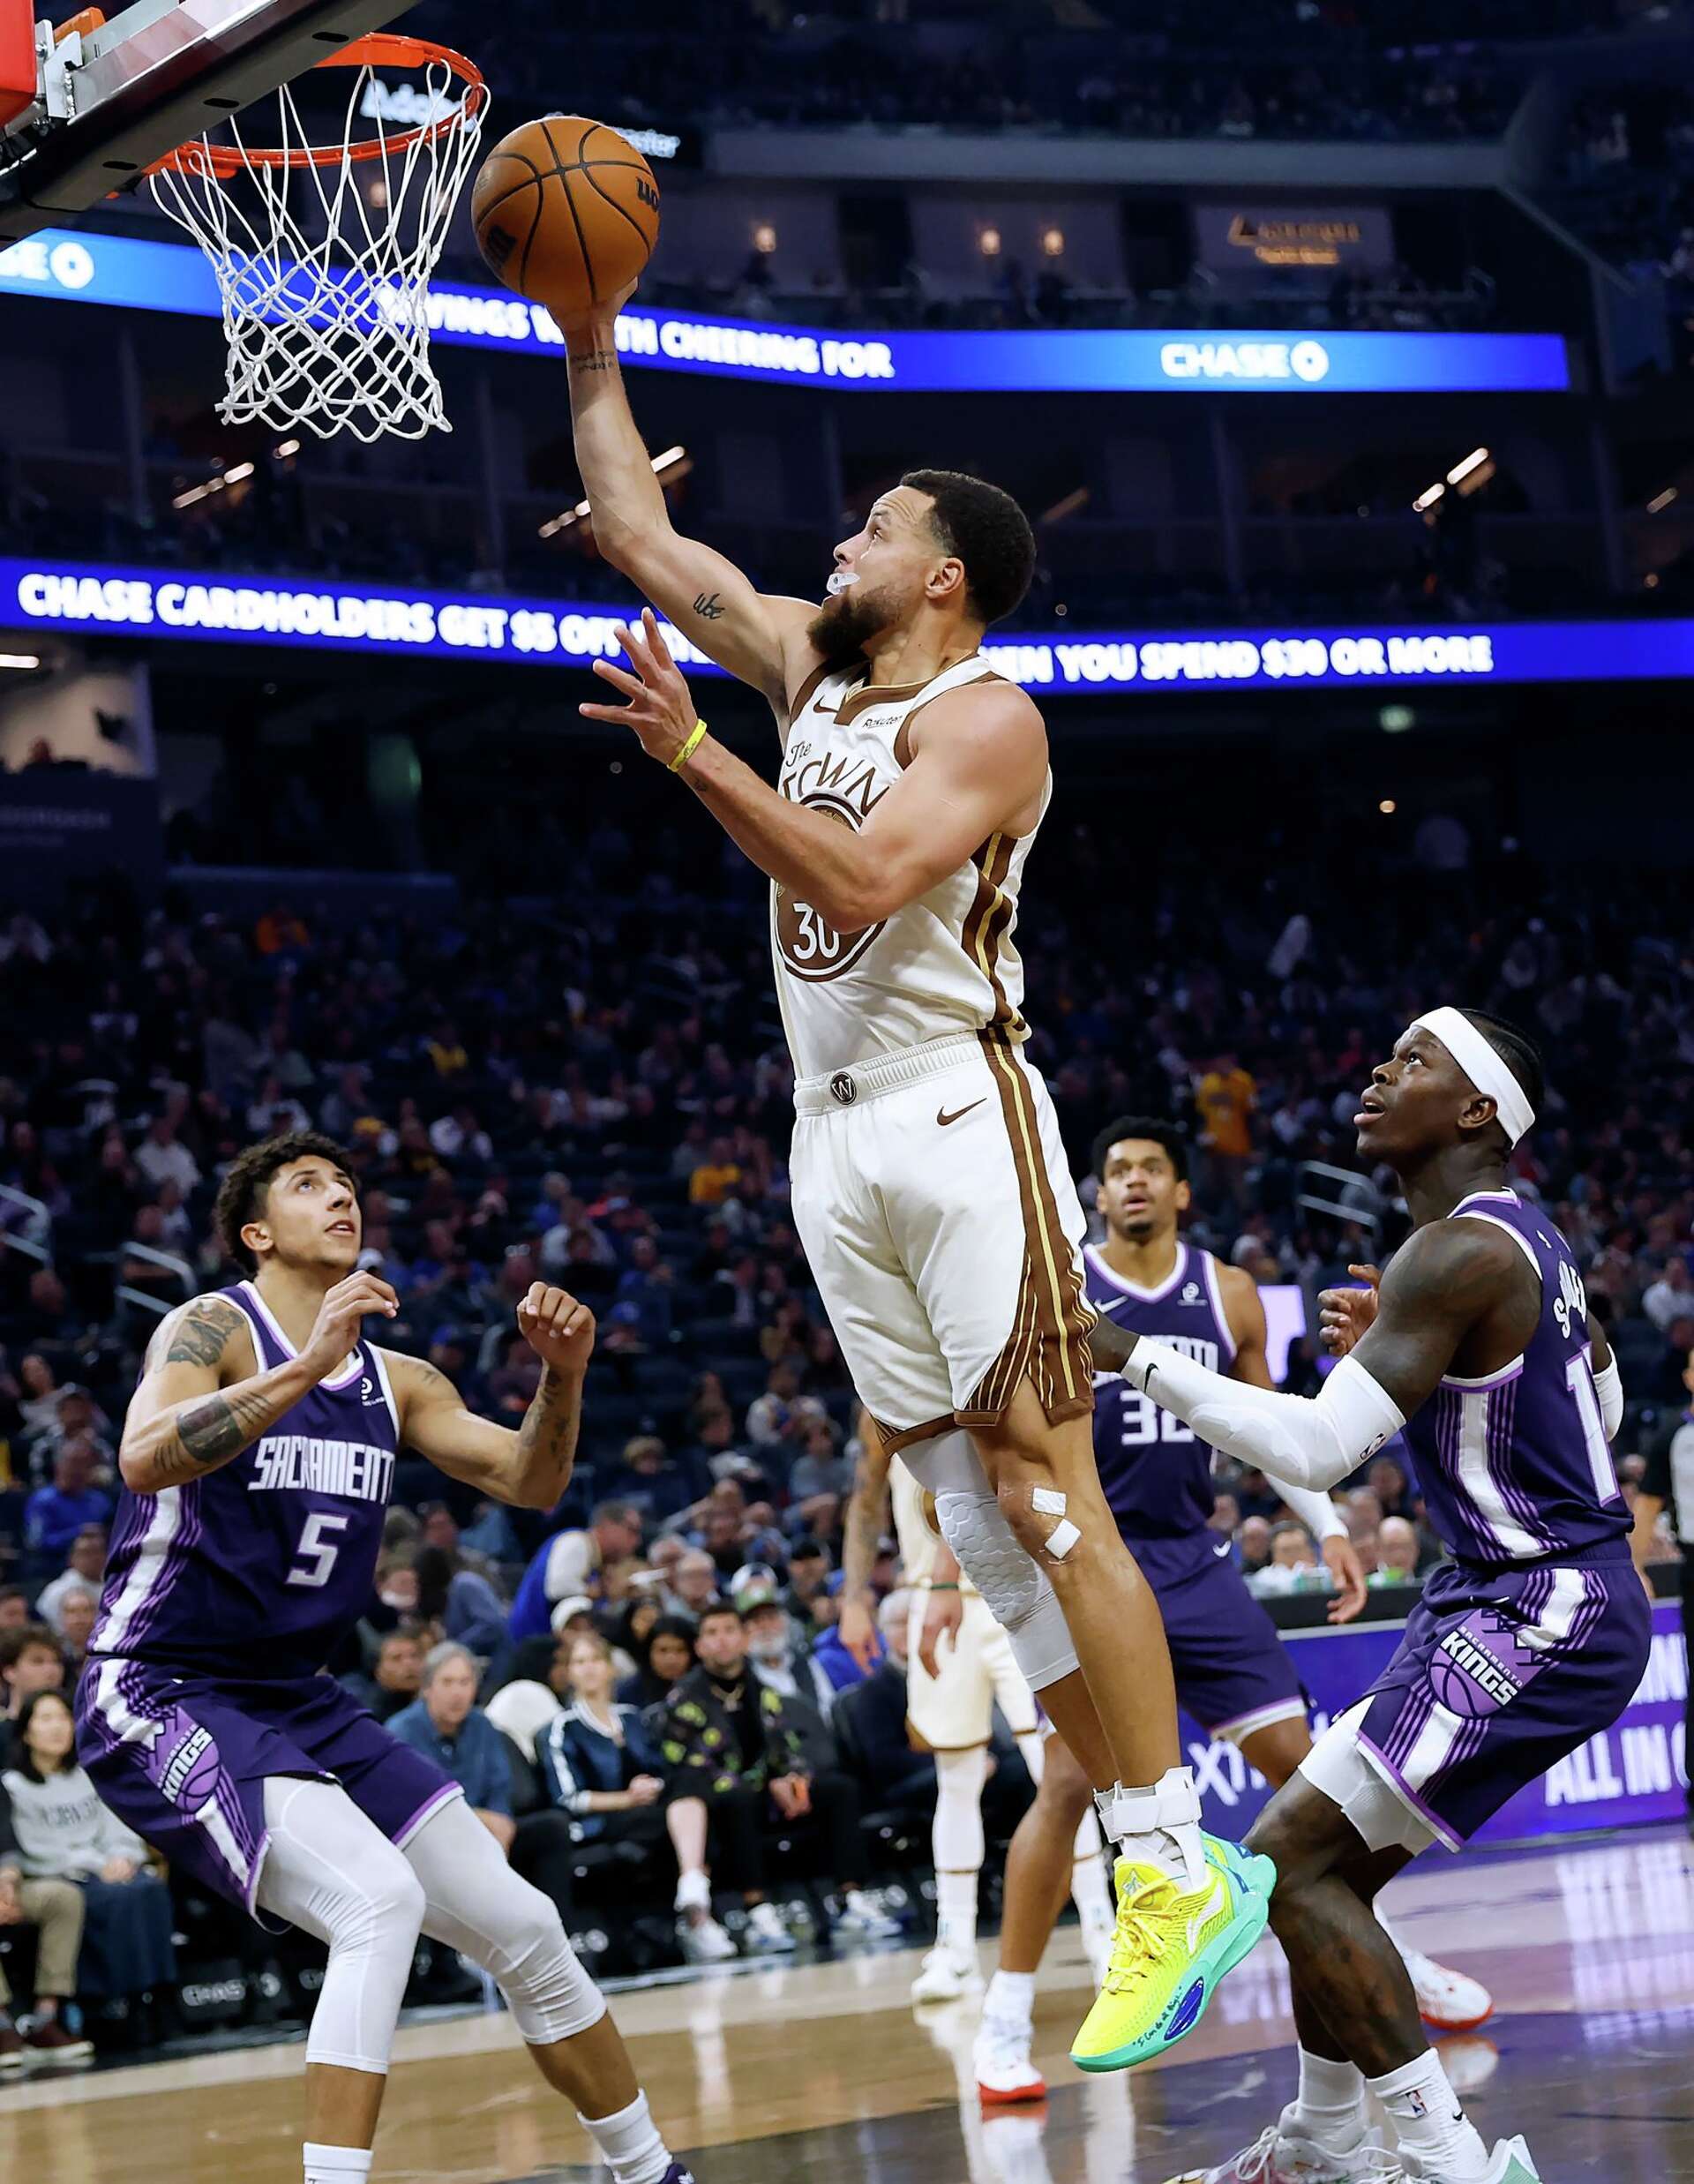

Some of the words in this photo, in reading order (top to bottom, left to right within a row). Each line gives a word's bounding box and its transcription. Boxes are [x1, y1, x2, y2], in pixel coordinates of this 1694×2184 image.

[659, 321, 821, 374] CHEERING
[821, 339, 896, 379] FOR
[1160, 343, 1291, 379] CHASE
[18, 573, 154, 624] CHASE
[155, 582, 437, 643] CARDHOLDERS
[438, 604, 509, 649] GET
[509, 609, 558, 653] $5
[1054, 642, 1138, 683] YOU
[1139, 641, 1261, 681] SPEND
[1260, 638, 1329, 679] $30
[1330, 637, 1388, 675] OR
[1387, 635, 1494, 674] MORE
[785, 740, 813, 768] The
[792, 902, 840, 960] 30
[245, 1435, 395, 1505] SACRAMENT
[284, 1512, 349, 1587] 5
[1439, 1629, 1518, 1707] KINGS
[1456, 1625, 1524, 1689] SACRAMENTO
[161, 1726, 214, 1805] KINGS
[1545, 1730, 1623, 1807] ALL
[1621, 1723, 1673, 1796] IN
